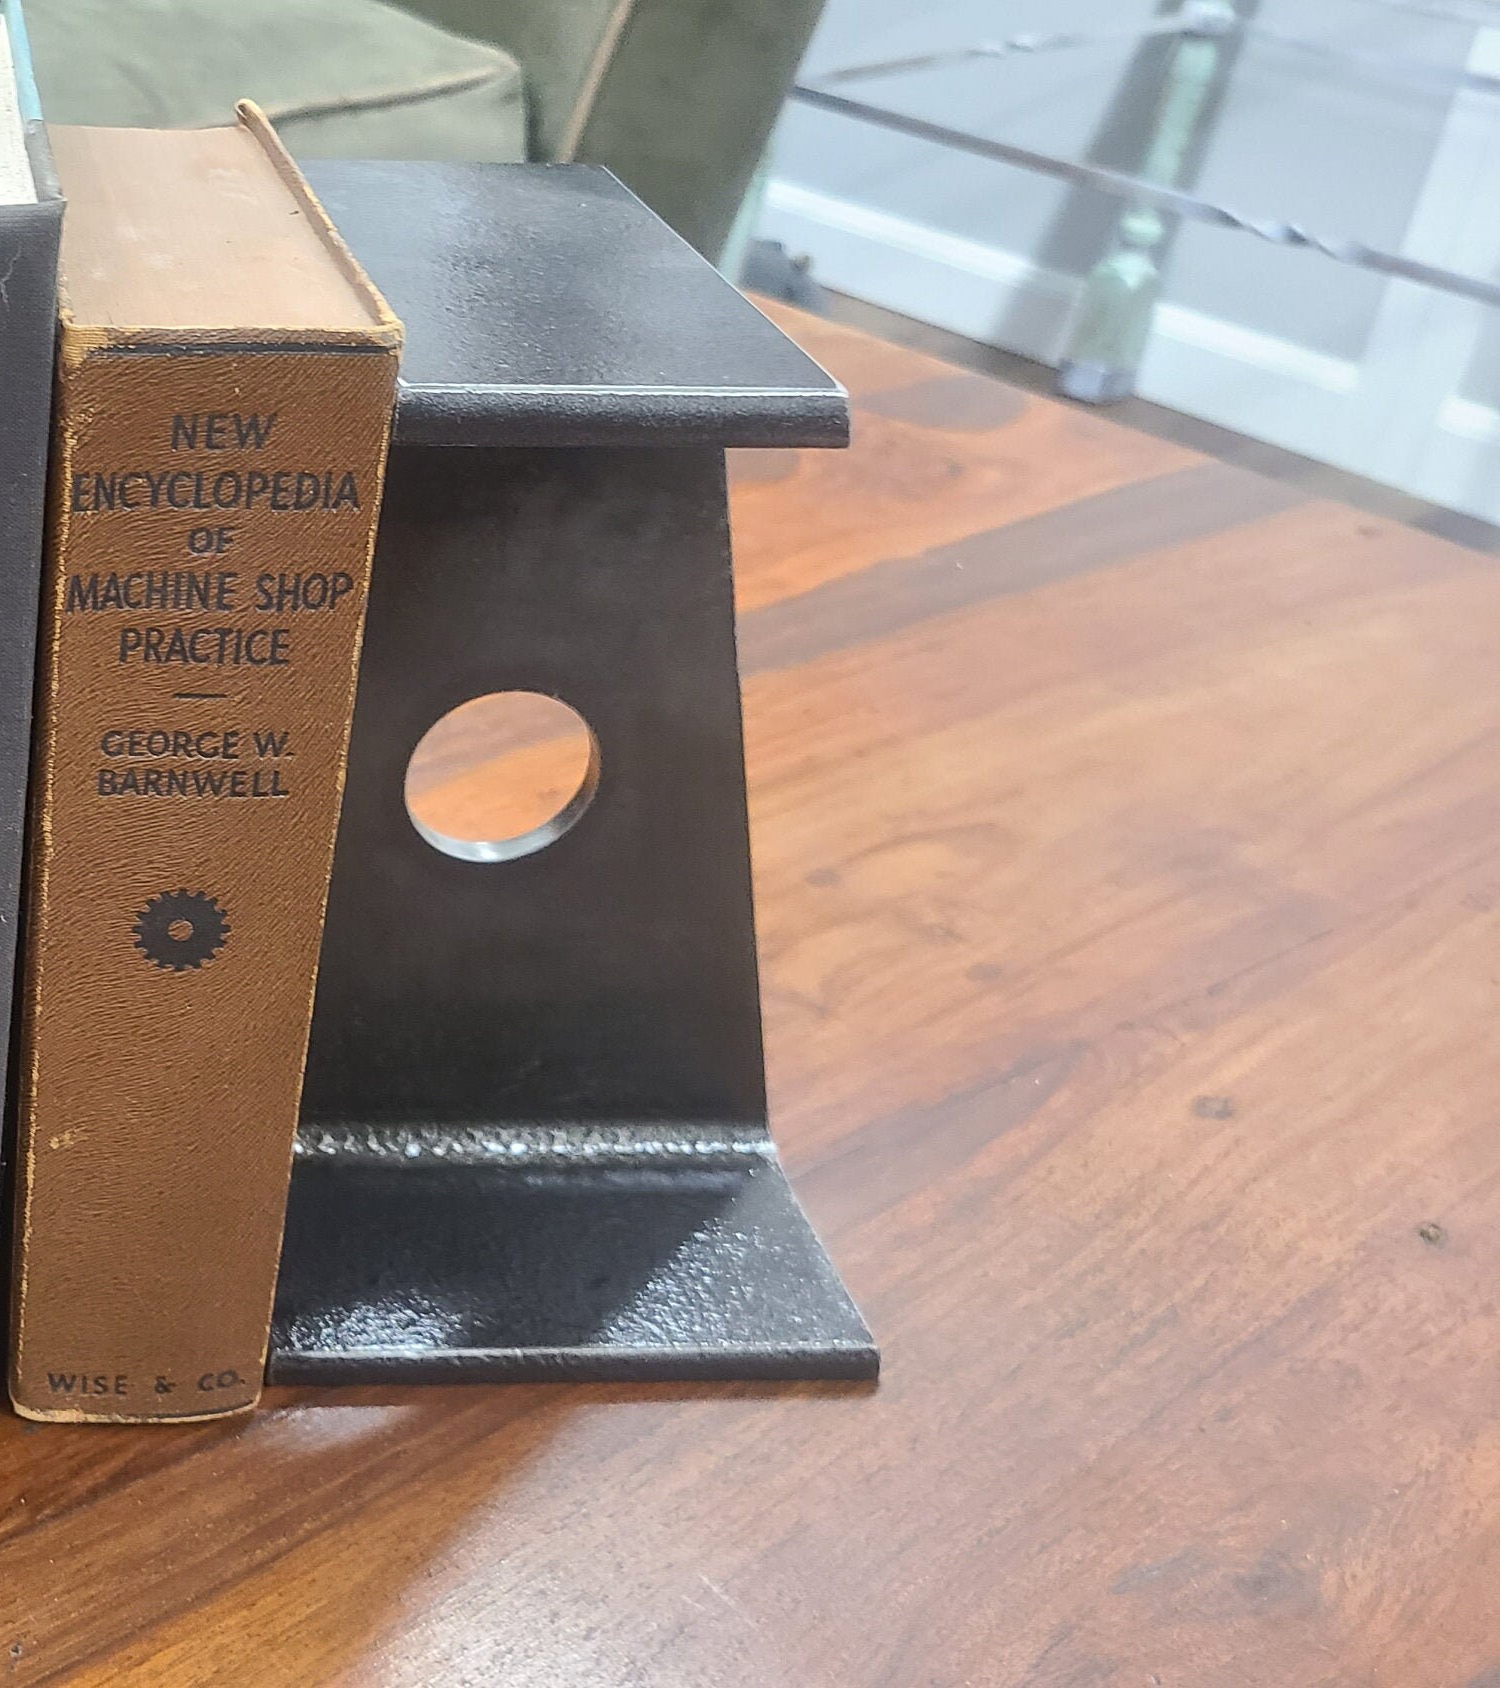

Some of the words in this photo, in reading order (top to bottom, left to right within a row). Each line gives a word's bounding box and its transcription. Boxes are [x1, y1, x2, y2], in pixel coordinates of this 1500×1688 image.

[171, 413, 278, 450] NEW
[72, 471, 361, 512] ENCYCLOPEDIA
[188, 526, 235, 555] OF
[66, 572, 238, 614] MACHINE
[255, 572, 354, 612] SHOP
[119, 627, 291, 666] PRACTICE
[102, 731, 239, 760] GEORGE
[253, 731, 294, 758] W.
[96, 769, 289, 798] BARNWELL
[48, 1373, 128, 1395] WISE
[155, 1376, 176, 1394] &
[197, 1370, 246, 1392] CO.
